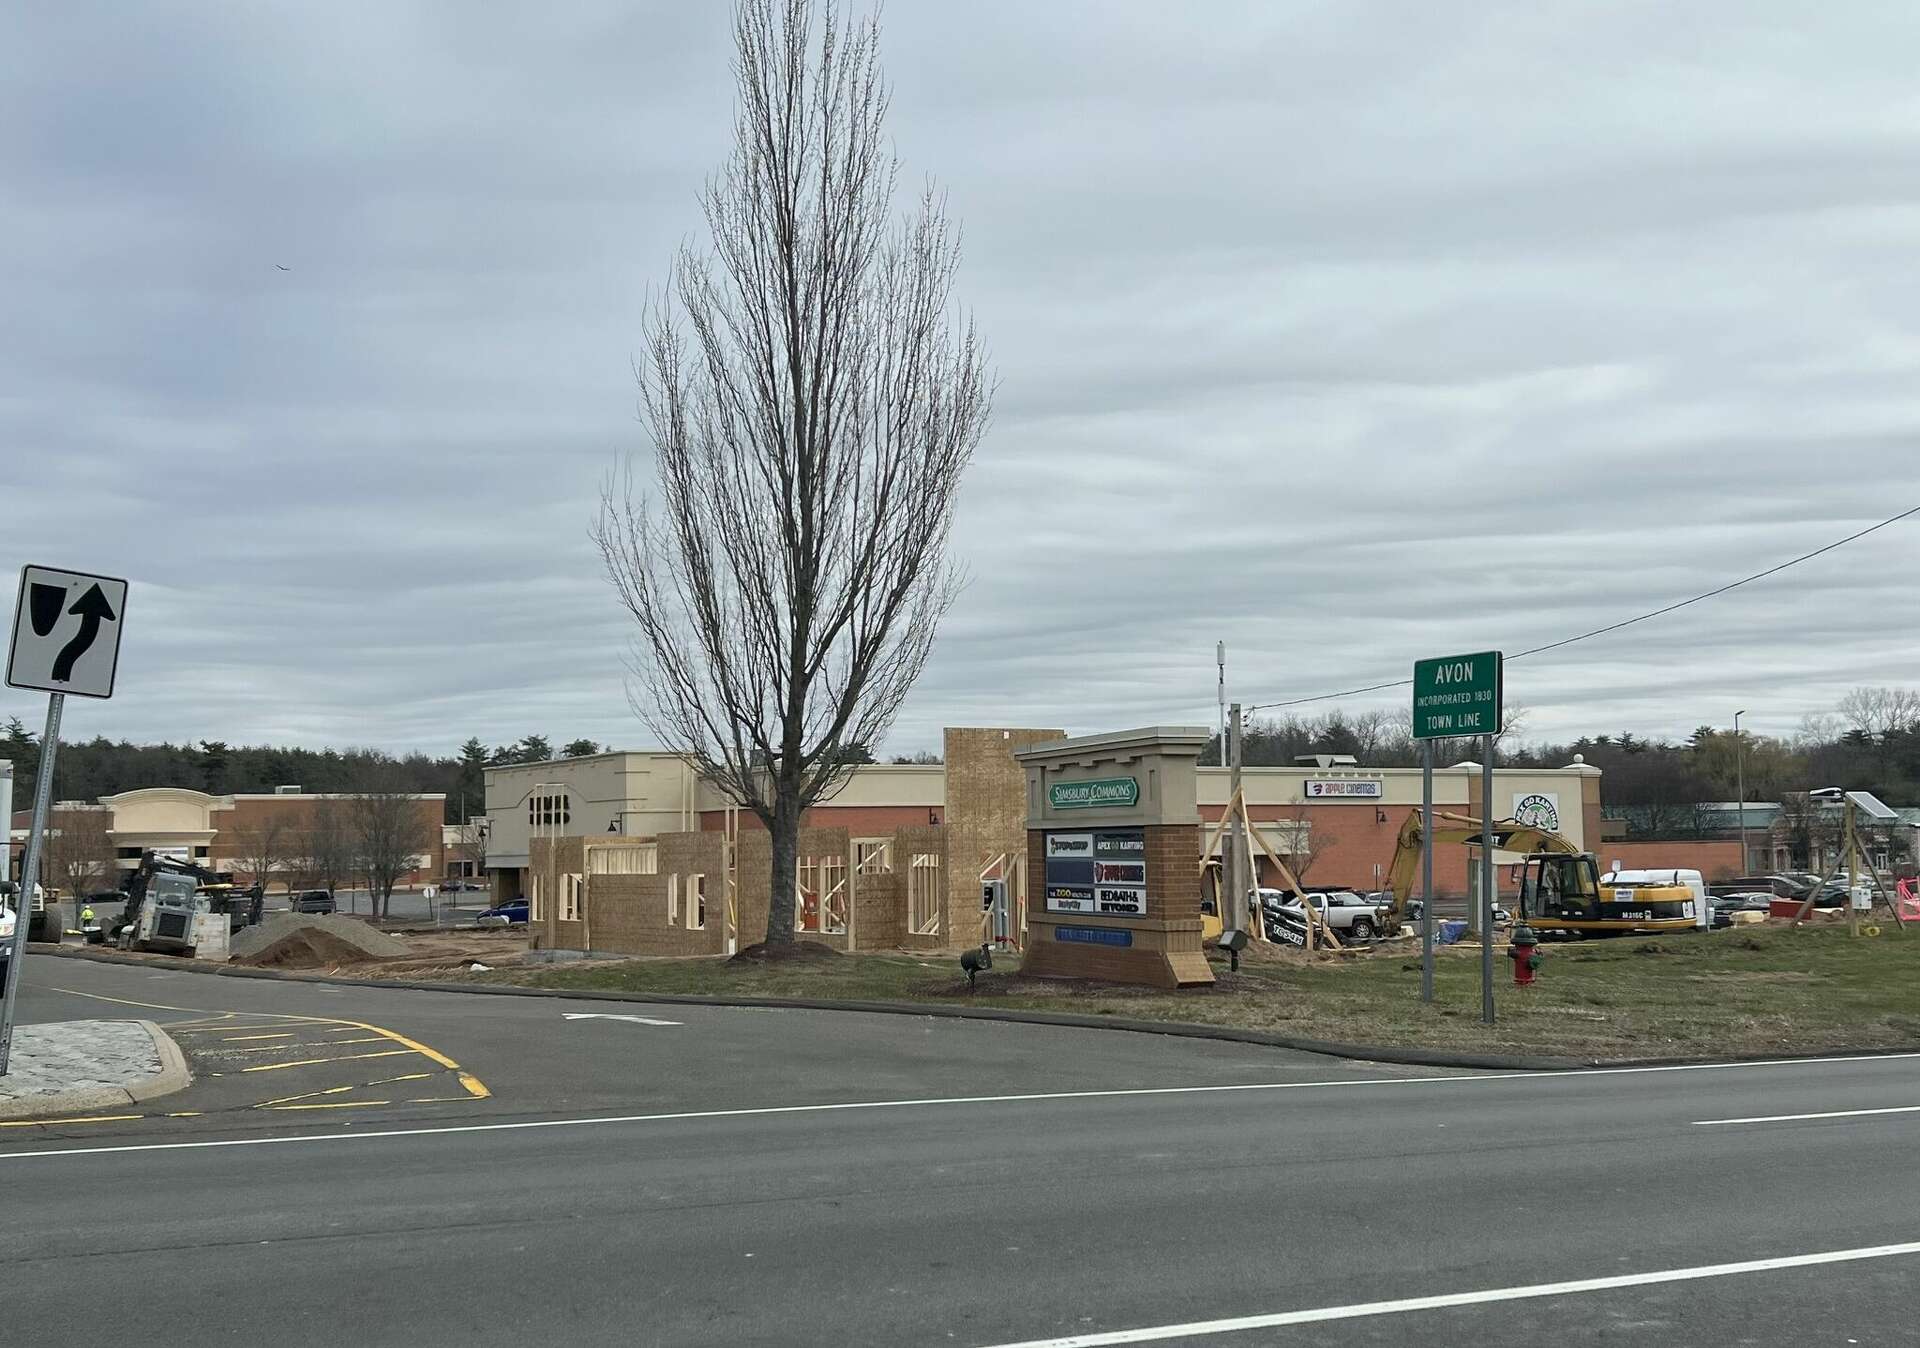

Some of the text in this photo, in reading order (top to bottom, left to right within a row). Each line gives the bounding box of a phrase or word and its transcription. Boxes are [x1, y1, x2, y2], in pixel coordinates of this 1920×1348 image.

[1434, 661, 1473, 685] AVON
[1417, 692, 1471, 707] INCORPORATED
[1426, 712, 1481, 730] TOWN LINE
